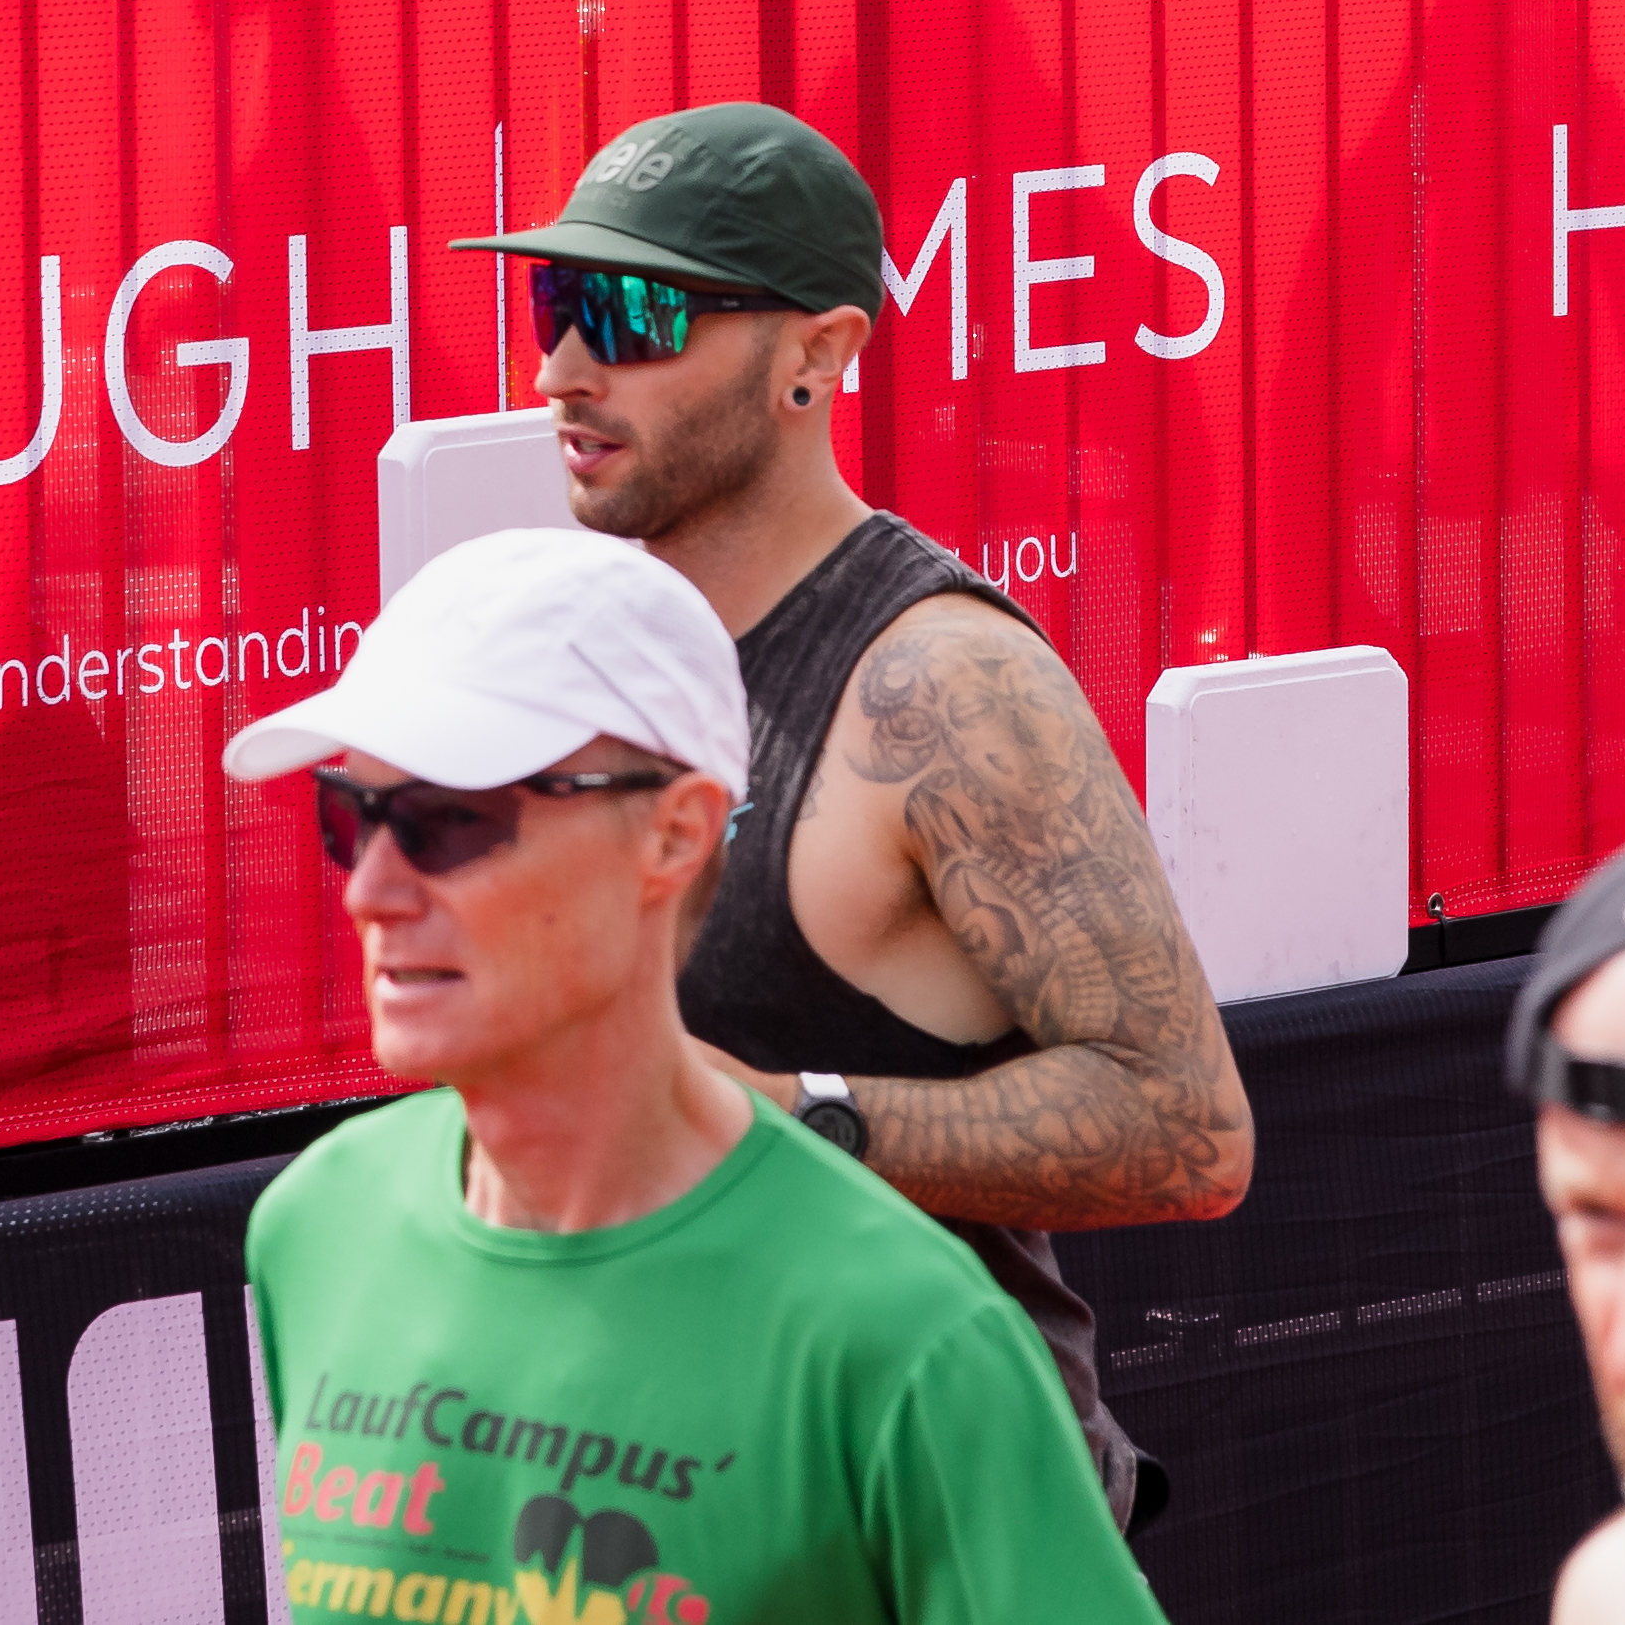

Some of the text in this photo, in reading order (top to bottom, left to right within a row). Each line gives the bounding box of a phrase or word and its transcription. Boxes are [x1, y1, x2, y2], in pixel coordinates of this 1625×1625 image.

[842, 151, 1226, 393] MES
[983, 531, 1077, 595] you
[282, 1441, 446, 1536] Beat
[282, 1546, 521, 1625] ermany
